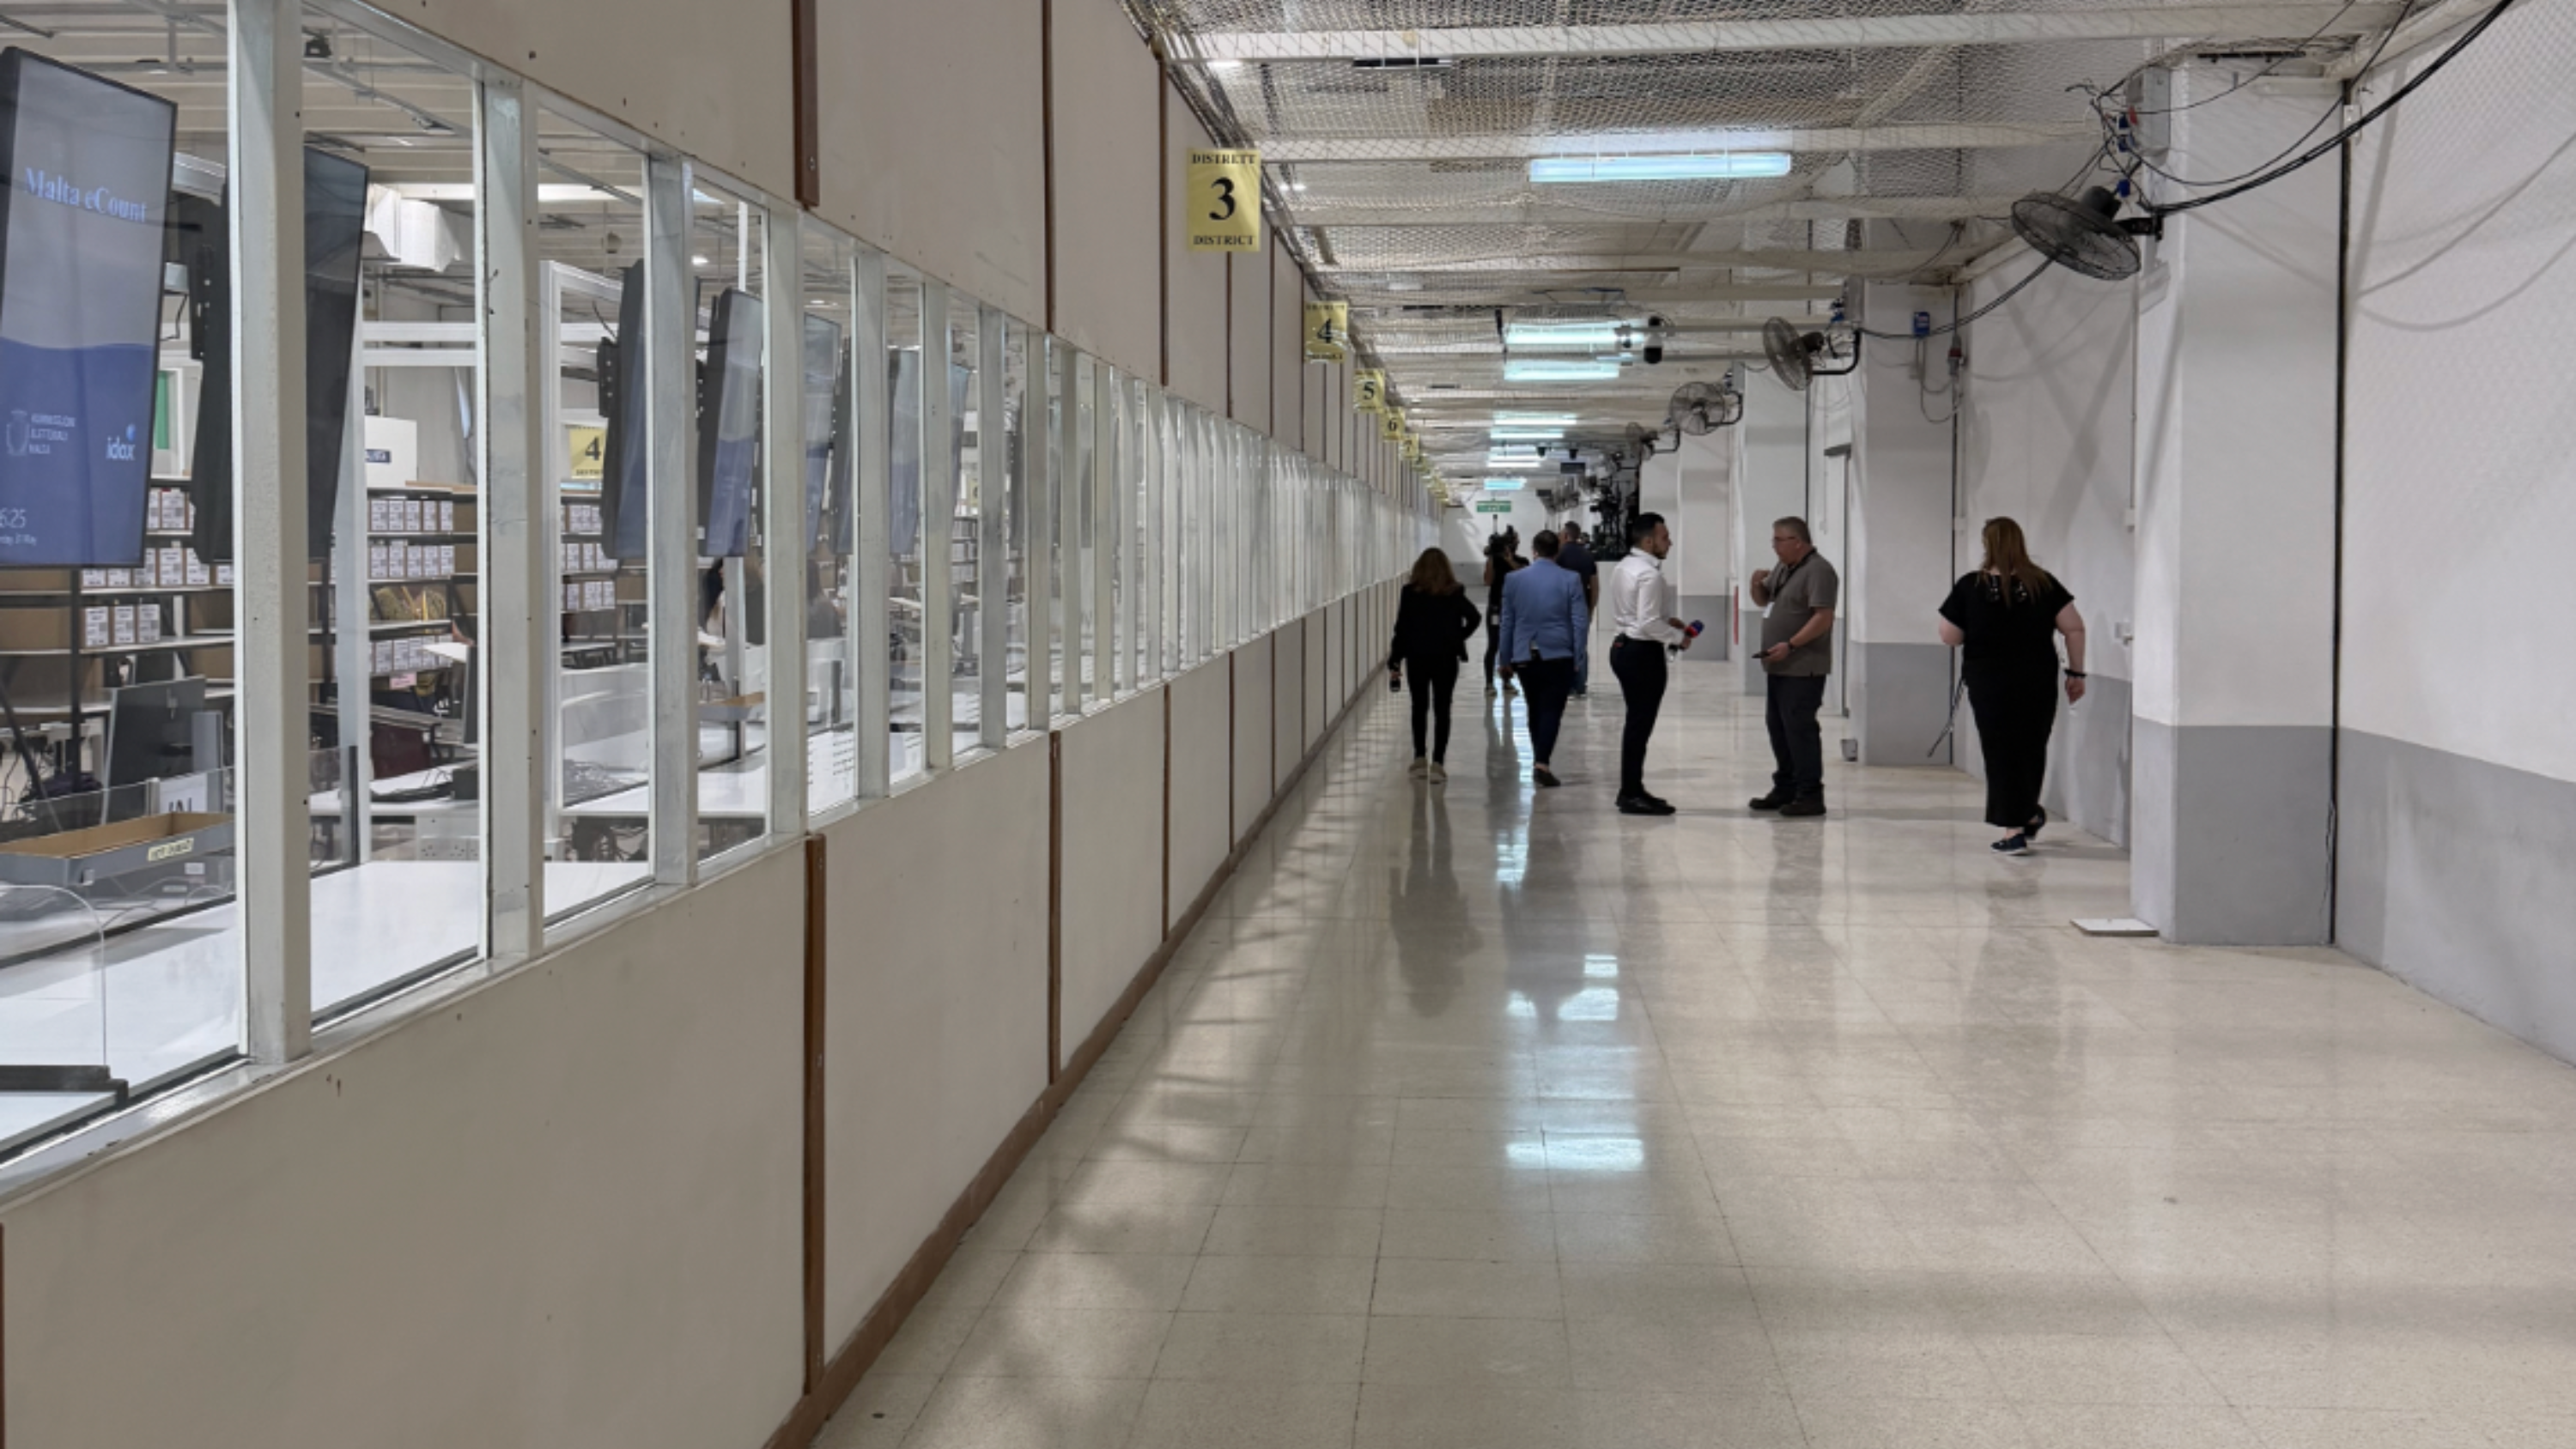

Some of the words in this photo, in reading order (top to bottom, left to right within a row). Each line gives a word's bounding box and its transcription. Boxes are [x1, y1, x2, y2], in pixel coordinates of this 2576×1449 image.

[1192, 153, 1256, 164] DISTRETT
[24, 167, 80, 207] Malta
[84, 185, 147, 223] eCount
[1208, 177, 1236, 221] 3
[1192, 234, 1256, 246] DISTRICT
[1316, 317, 1334, 344] 4
[1363, 380, 1376, 400] 5
[584, 435, 602, 461] 4
